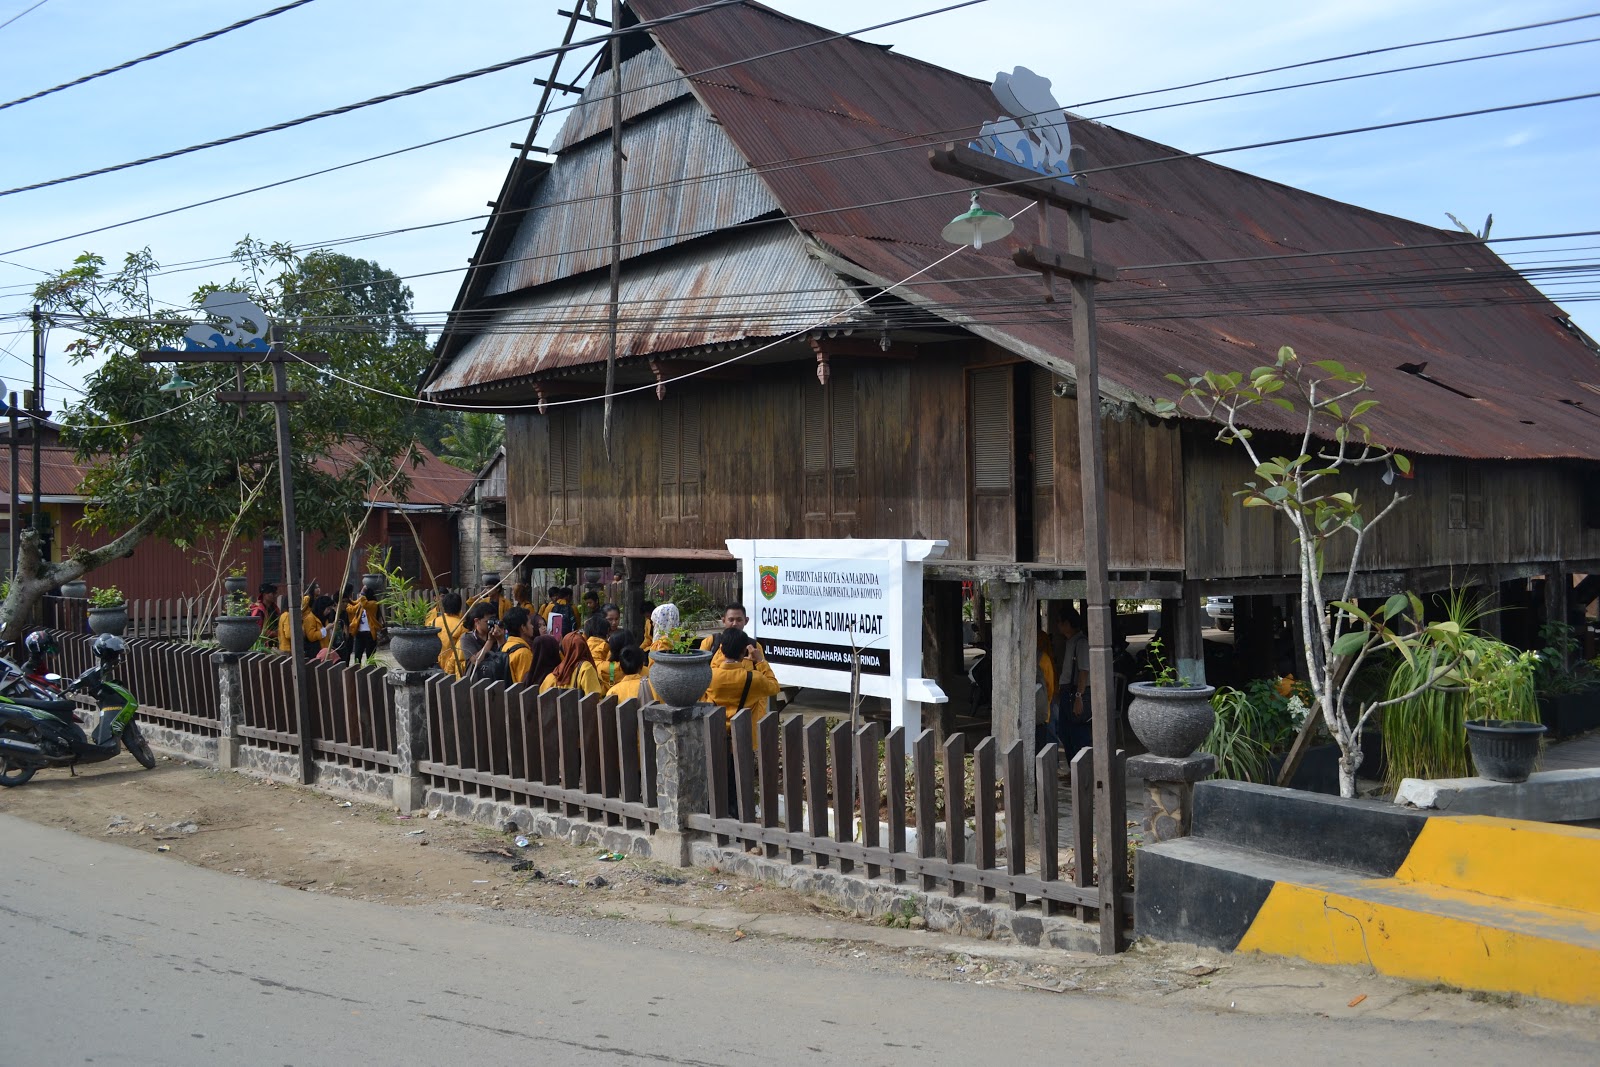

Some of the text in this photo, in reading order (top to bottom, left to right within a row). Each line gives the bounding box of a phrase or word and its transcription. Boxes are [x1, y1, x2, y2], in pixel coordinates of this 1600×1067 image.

[785, 570, 879, 585] PEMERINTAH KOTA SAMARINDA
[850, 587, 860, 598] DAN
[860, 588, 883, 600] KOMINFO
[761, 607, 883, 634] CAGAR BUDAYA RUMAH ADAT
[764, 645, 881, 667] JL. PANGERAN BENDAHARA SARINDA
